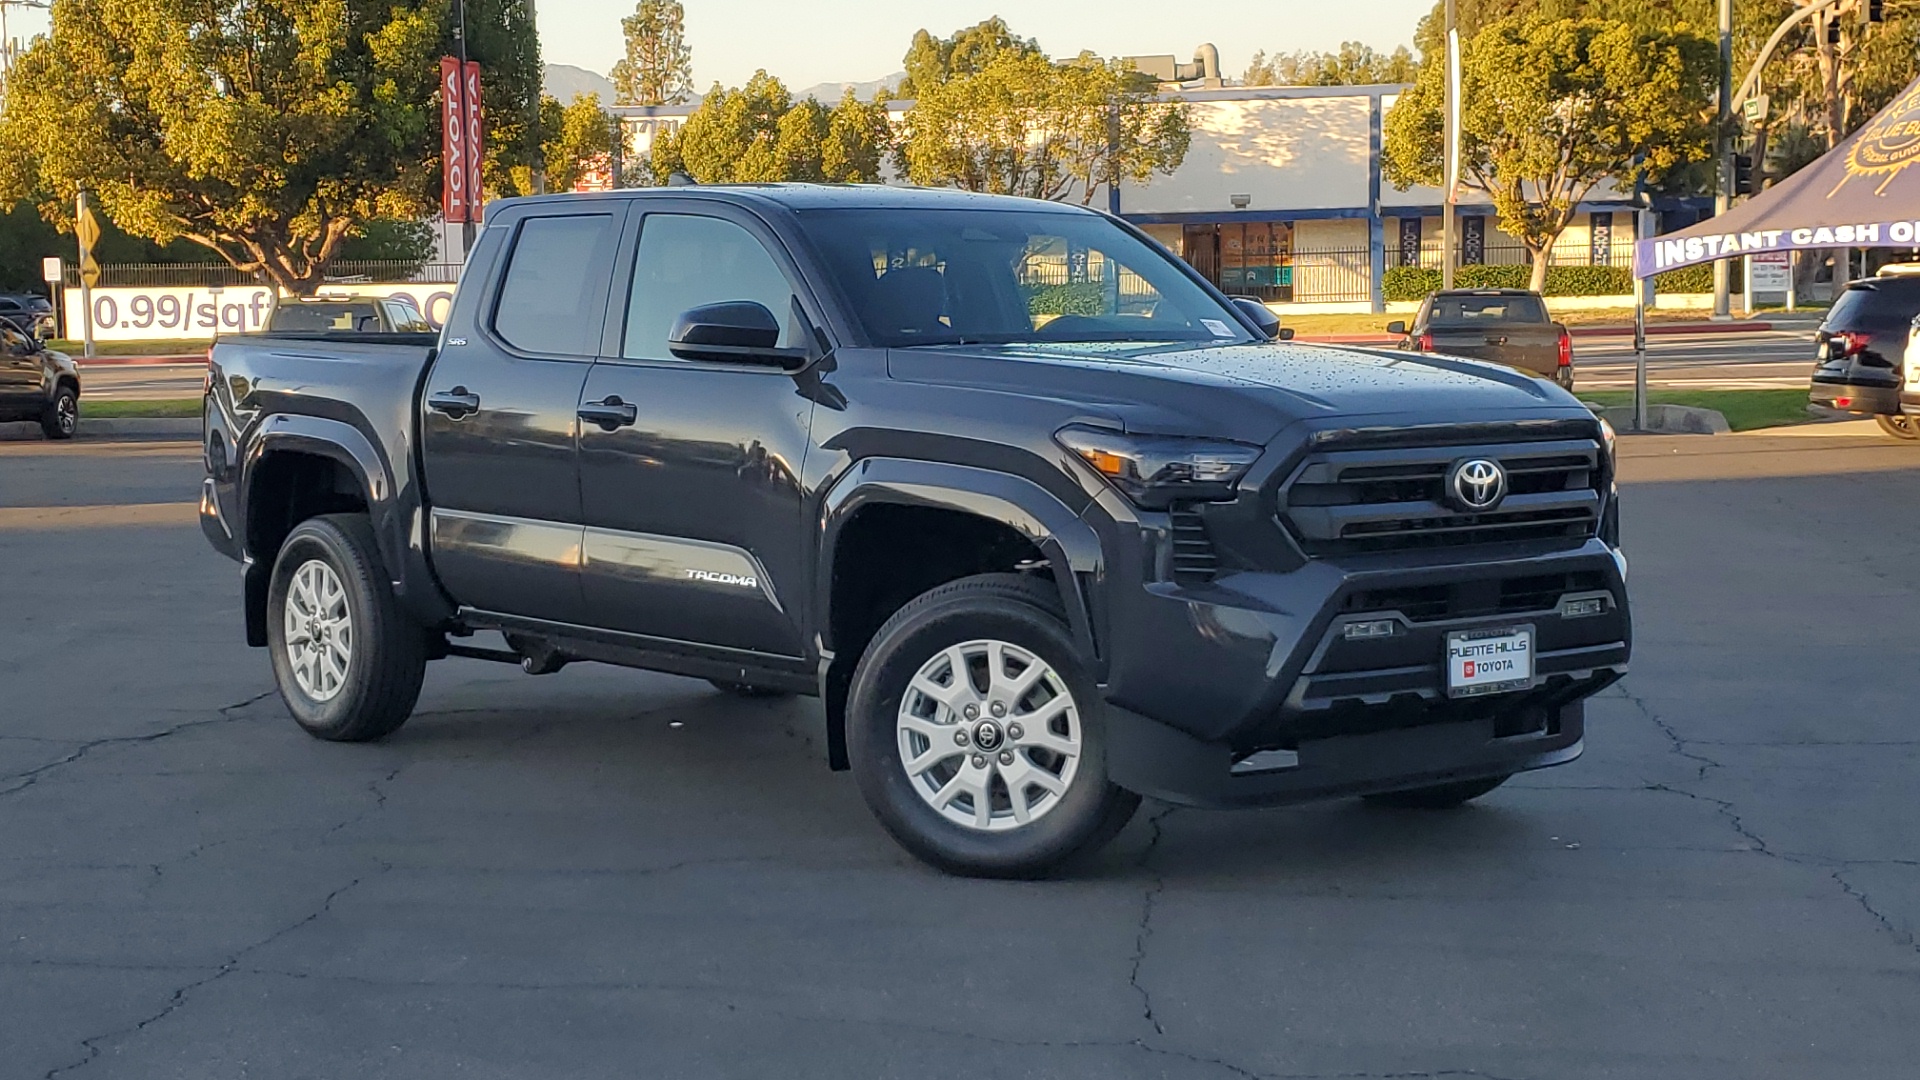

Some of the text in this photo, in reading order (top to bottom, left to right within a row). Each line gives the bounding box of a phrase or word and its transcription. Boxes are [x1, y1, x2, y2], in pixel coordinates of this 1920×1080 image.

[447, 70, 461, 214] TOYOTA
[468, 72, 480, 214] TOYOTA
[1889, 143, 1920, 161] GUID
[1403, 221, 1417, 267] FLOORIN
[1466, 220, 1480, 266] FLOORIN
[1654, 230, 1783, 269] INSTANT
[1791, 224, 1879, 246] CASH
[1889, 221, 1920, 243] O
[93, 291, 273, 333] 0.99/sqf
[685, 568, 757, 588] TACOMA
[1450, 640, 1527, 658] PUENTE HILLS
[1476, 659, 1513, 674] TOYOTA
